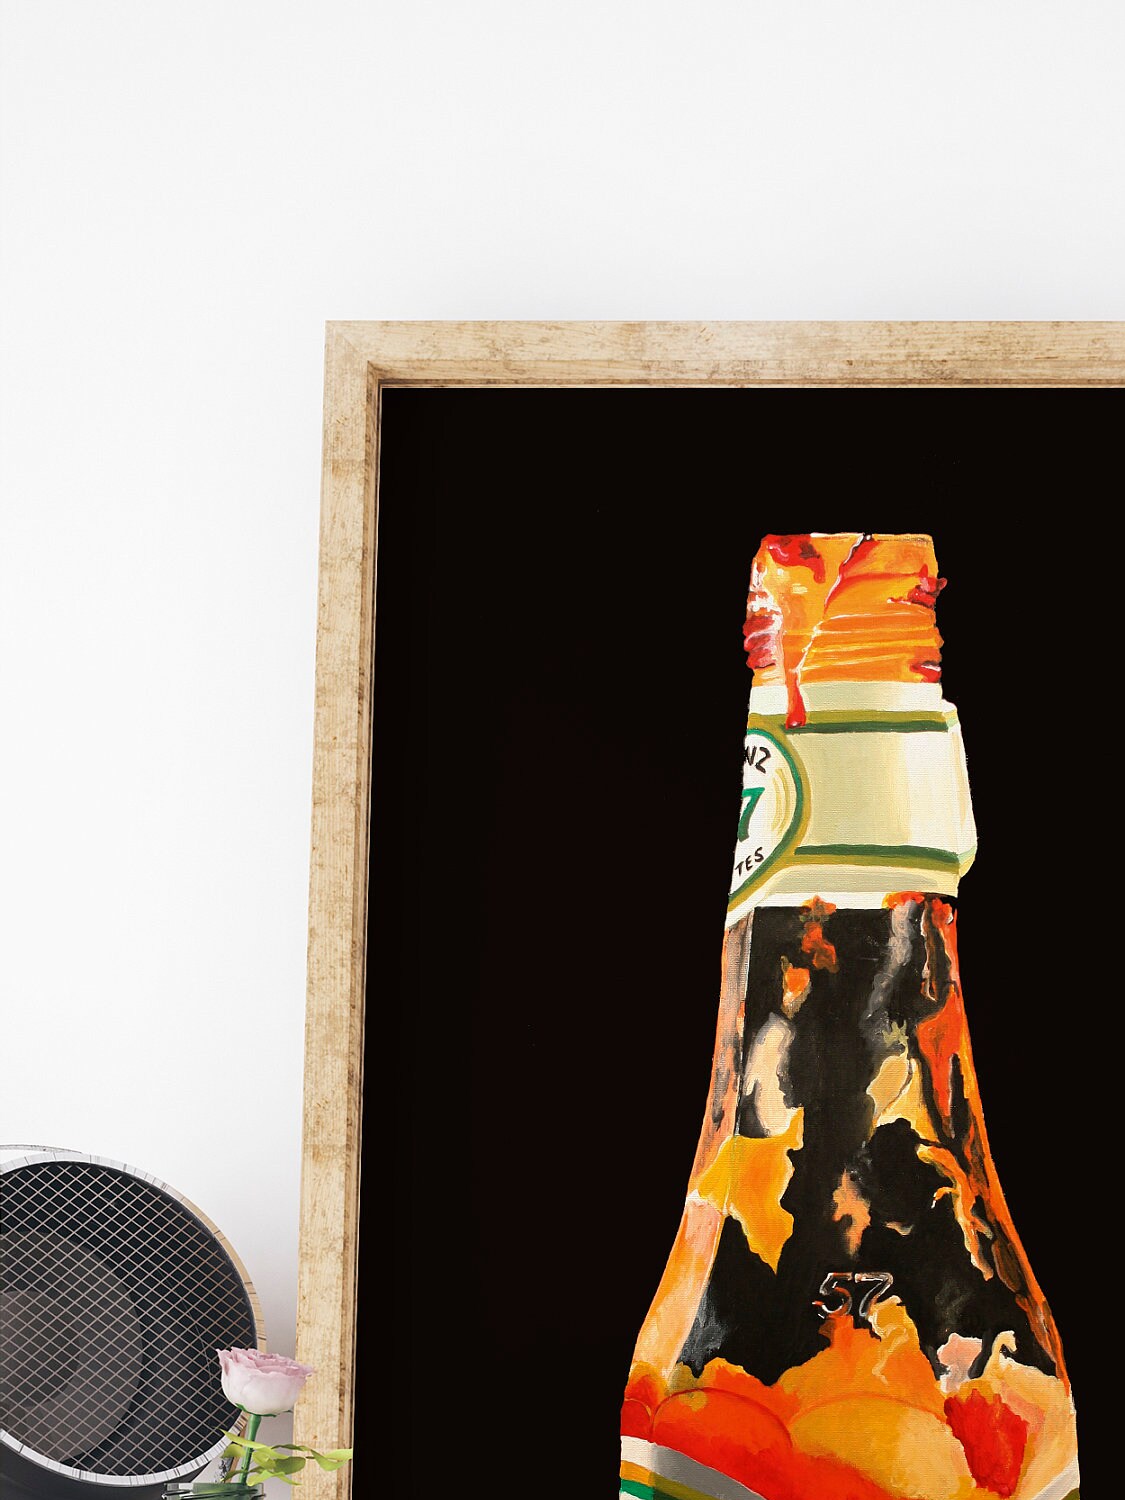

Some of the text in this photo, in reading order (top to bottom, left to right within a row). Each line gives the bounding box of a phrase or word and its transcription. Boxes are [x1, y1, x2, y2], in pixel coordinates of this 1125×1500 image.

[737, 787, 765, 842] 7
[734, 847, 764, 876] TES
[811, 1271, 894, 1319] 57
